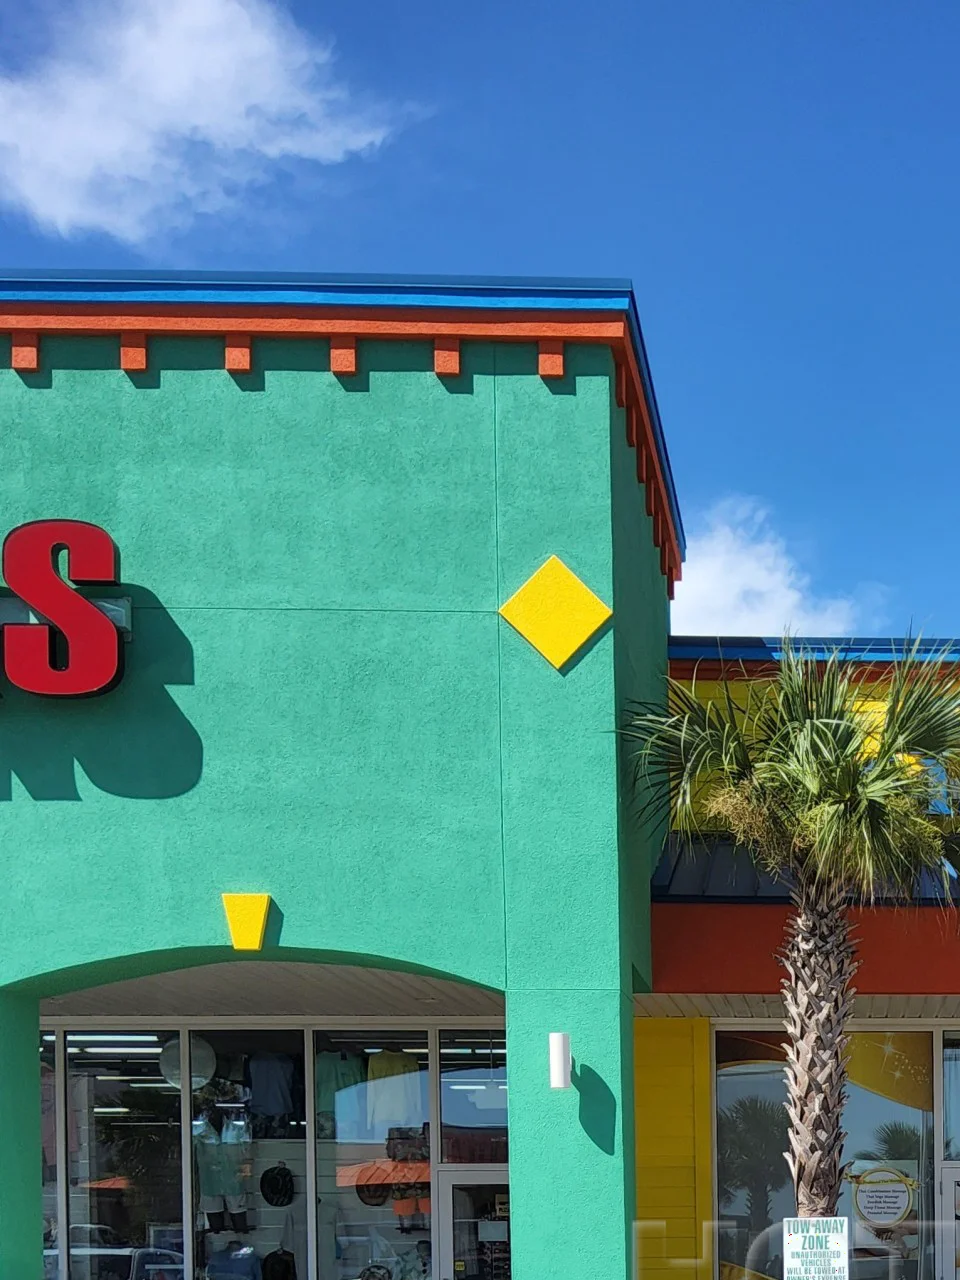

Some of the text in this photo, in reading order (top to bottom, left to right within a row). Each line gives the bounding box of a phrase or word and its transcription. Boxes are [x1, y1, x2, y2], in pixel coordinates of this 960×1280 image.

[801, 1235, 830, 1250] ZONE
[791, 1251, 841, 1259] UNAUTHORIZED
[801, 1259, 831, 1267] VEHICLES
[787, 1266, 845, 1275] WILL BE TOWED AT
